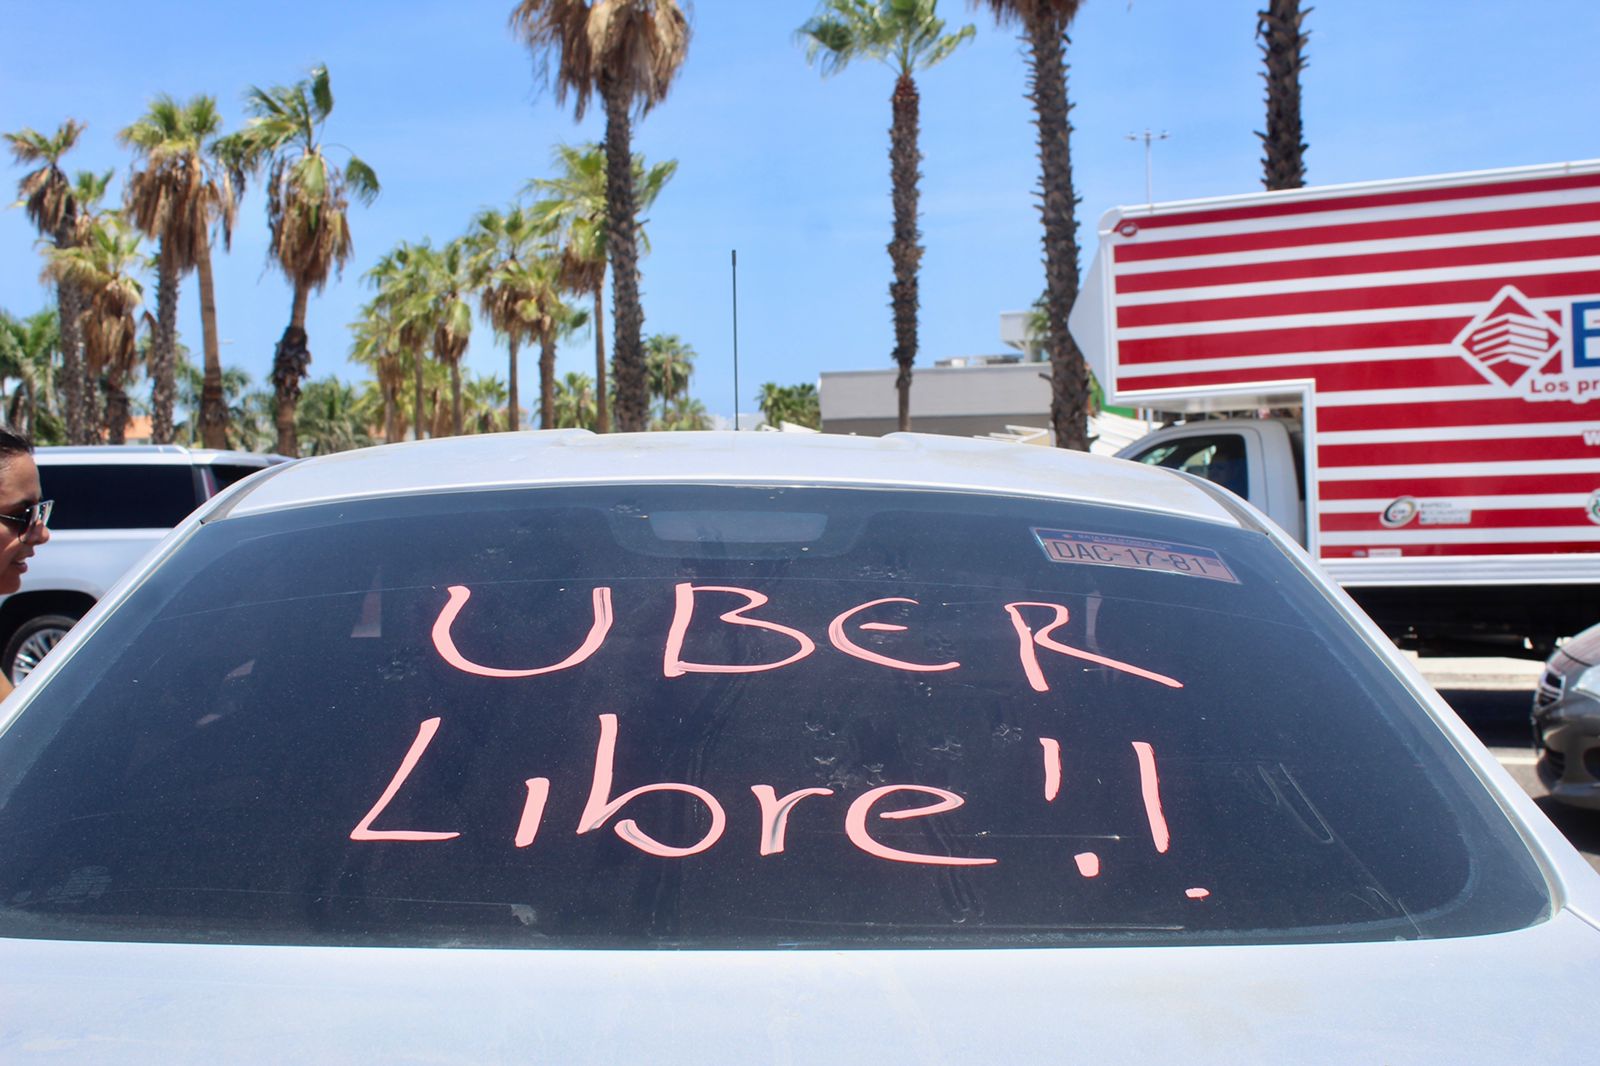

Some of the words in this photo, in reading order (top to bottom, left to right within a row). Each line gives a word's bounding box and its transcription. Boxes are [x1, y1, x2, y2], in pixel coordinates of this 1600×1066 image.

[1531, 380, 1569, 393] Los
[1052, 541, 1208, 574] DAC-17-81
[432, 583, 1183, 691] UBER
